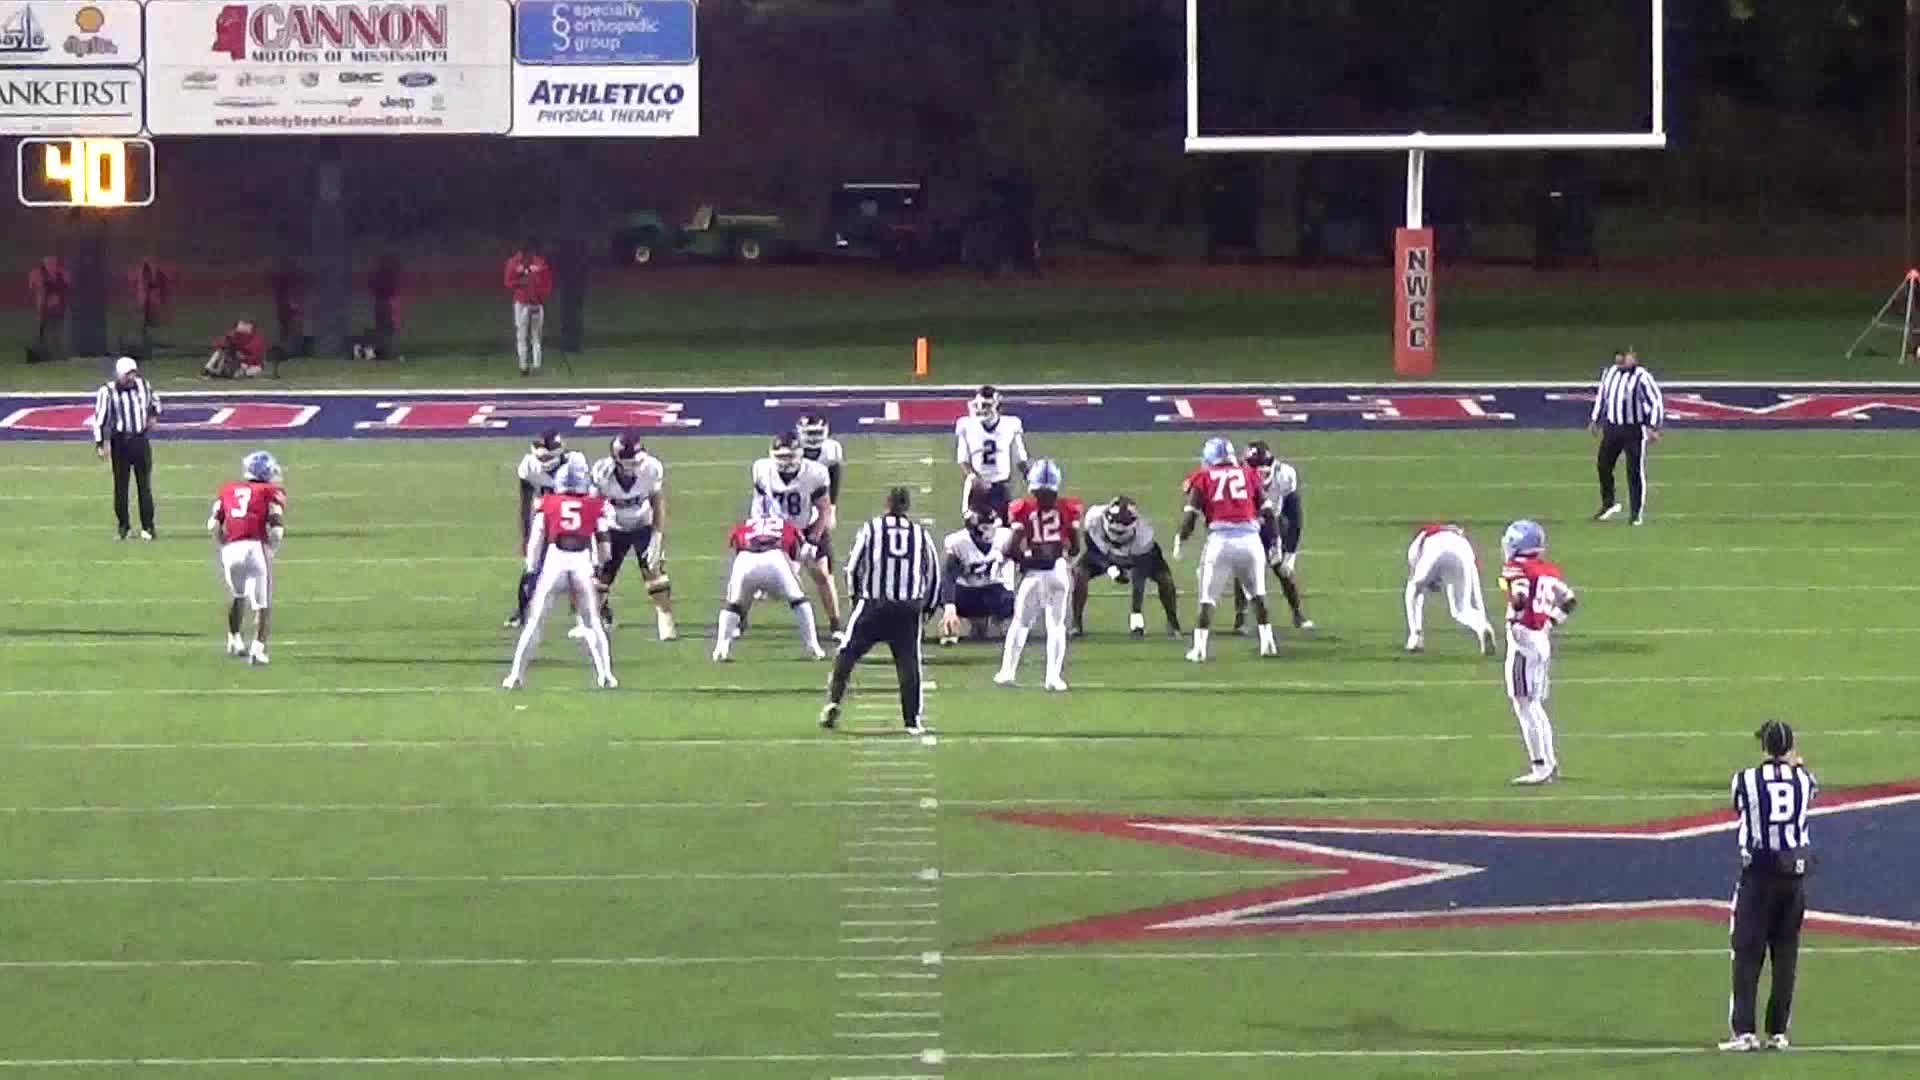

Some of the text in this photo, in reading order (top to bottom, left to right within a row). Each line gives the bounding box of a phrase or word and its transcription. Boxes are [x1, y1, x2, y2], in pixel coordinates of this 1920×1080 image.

[573, 2, 643, 18] specialty
[250, 3, 448, 50] CANNON
[574, 18, 659, 34] orthopedic
[574, 36, 622, 51] group
[351, 51, 448, 63] MISSISSIPPI
[338, 72, 384, 83] GMC
[380, 95, 415, 112] Jeep
[528, 80, 685, 105] ATHLETICO
[537, 109, 674, 123] PHYSICAL THERAPY
[45, 137, 126, 204] 40
[1406, 247, 1432, 350] NWCC
[983, 440, 997, 464] 2
[1209, 468, 1248, 501] 72
[231, 487, 252, 519] 3
[560, 500, 583, 530] 5
[1029, 510, 1061, 542] 12
[888, 528, 910, 555] U
[1767, 782, 1795, 821] B
